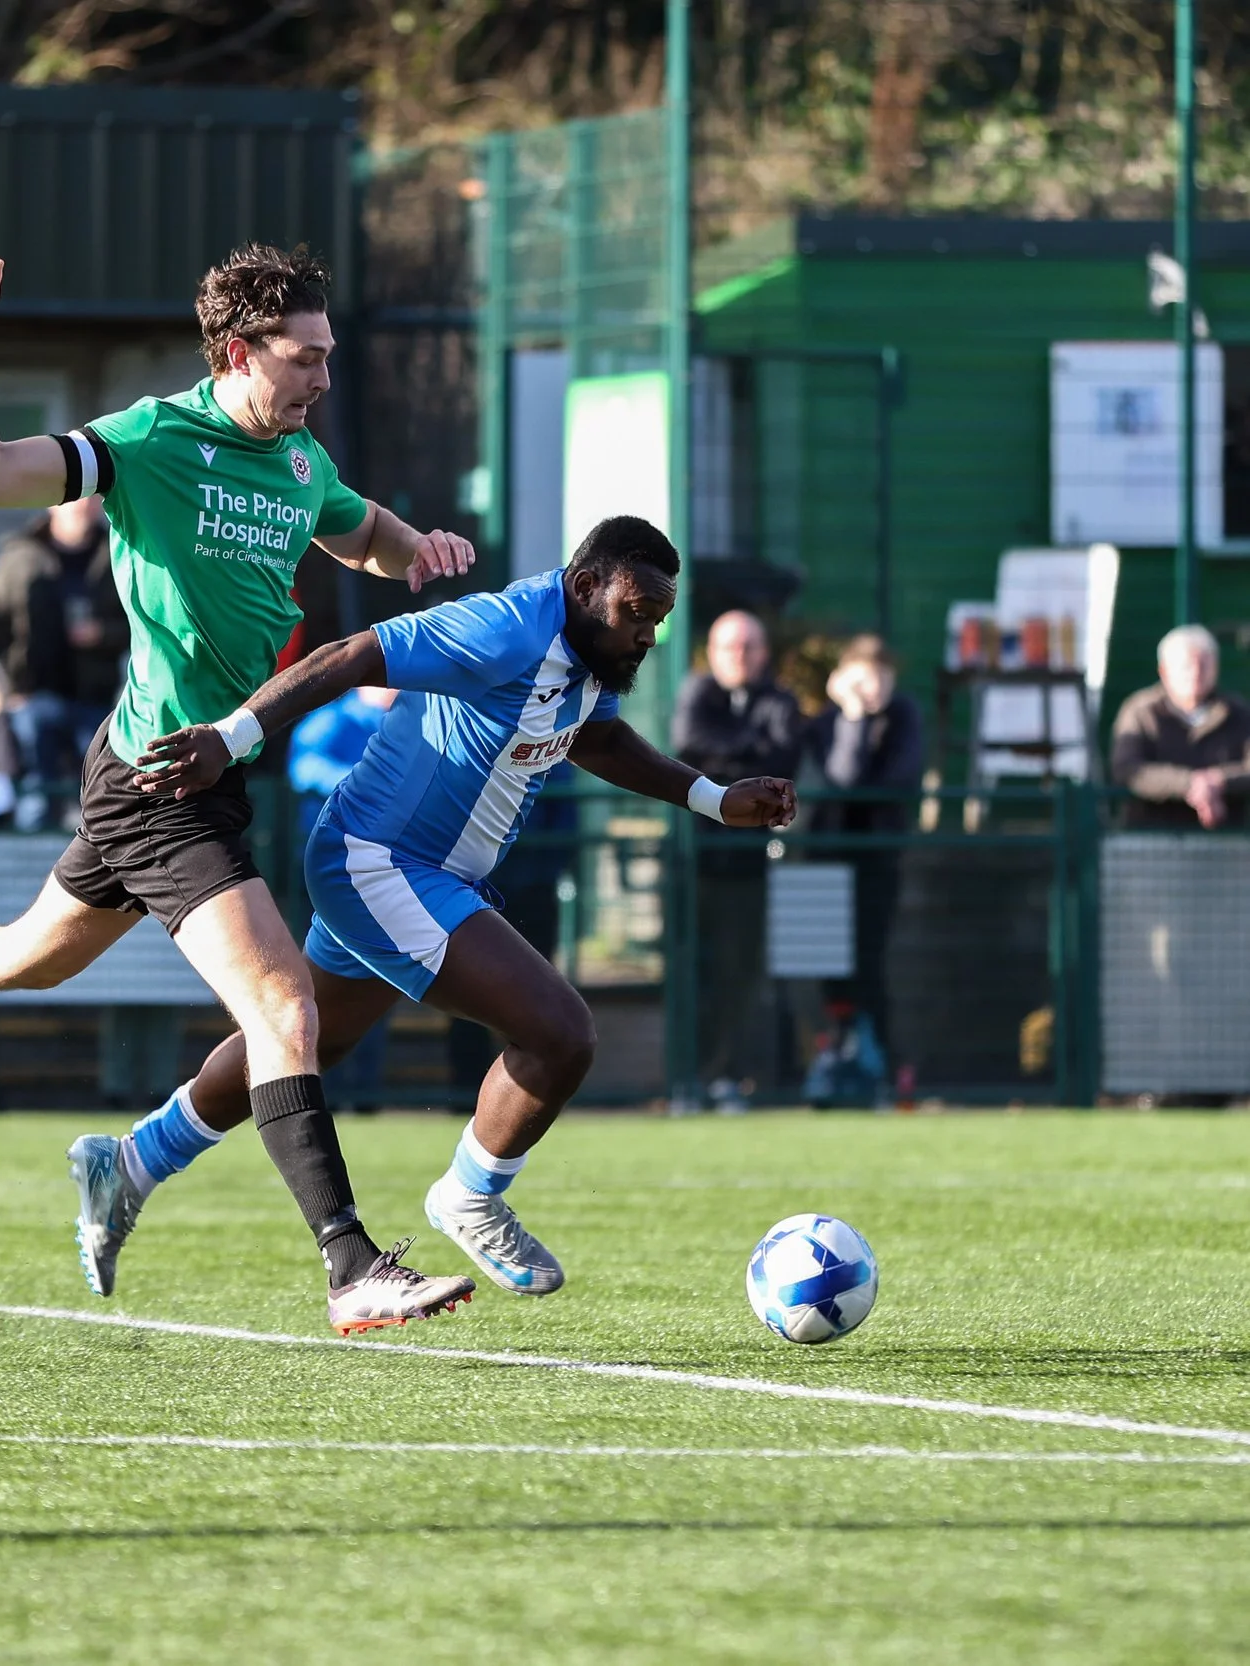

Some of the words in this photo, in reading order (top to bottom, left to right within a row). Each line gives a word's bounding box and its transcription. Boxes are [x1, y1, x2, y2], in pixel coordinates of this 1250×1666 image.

[198, 483, 247, 514] The
[253, 492, 312, 532] Priory
[197, 511, 292, 551] Hospital
[194, 543, 220, 558] Part
[222, 548, 236, 560] of
[237, 550, 262, 564] Circle
[263, 553, 286, 570] Health
